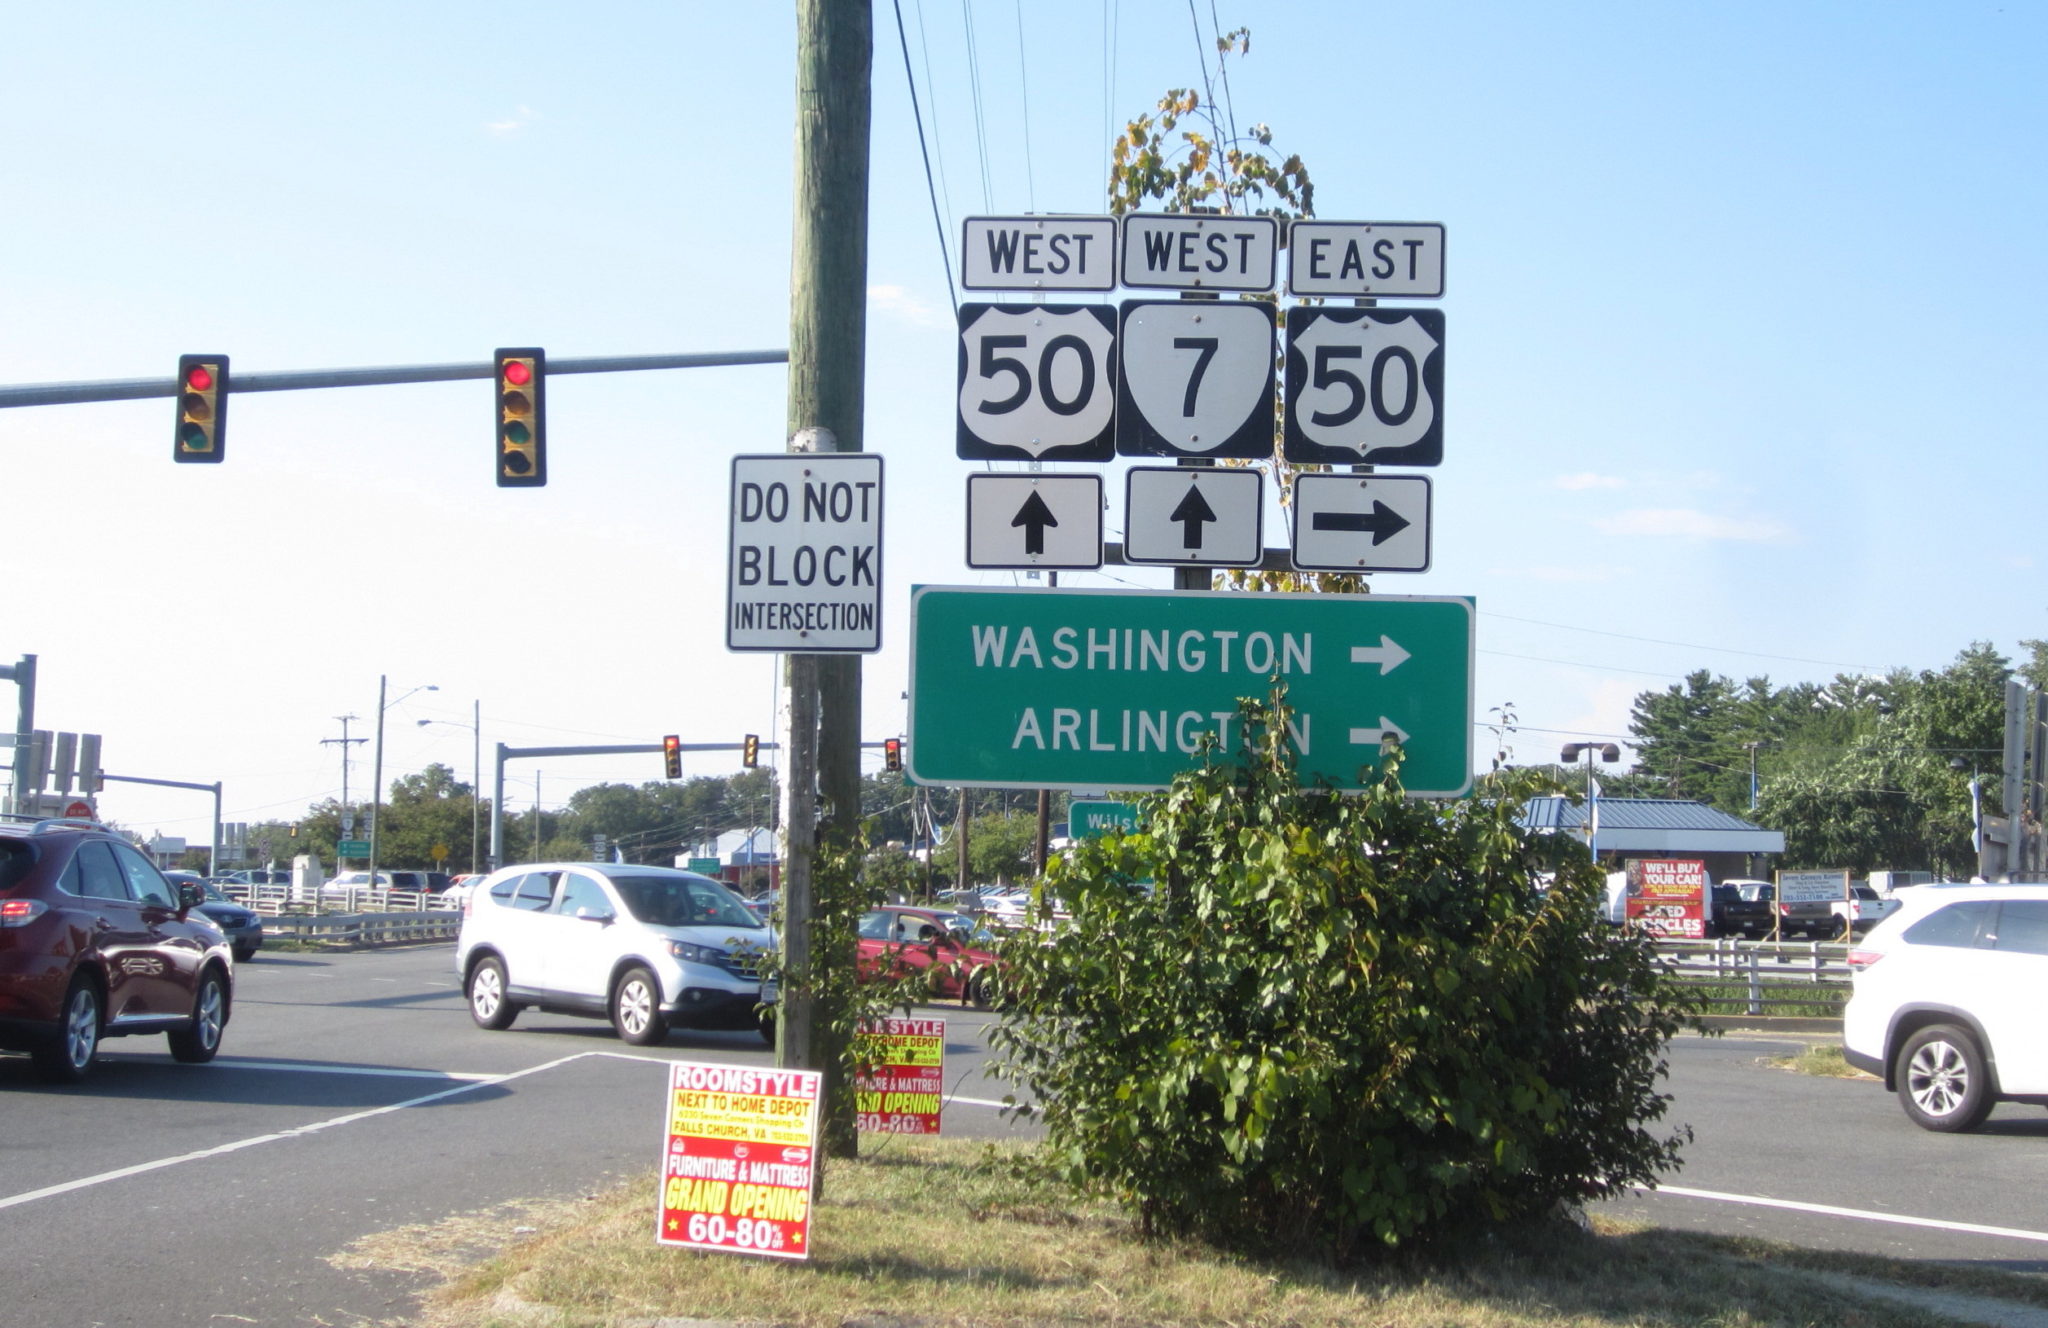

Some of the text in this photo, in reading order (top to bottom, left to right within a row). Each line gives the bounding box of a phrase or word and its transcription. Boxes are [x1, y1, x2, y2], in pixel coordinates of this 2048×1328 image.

[986, 229, 1094, 276] WEST
[1143, 230, 1256, 275] WEST
[1309, 238, 1425, 281] EAST
[977, 333, 1096, 416] 50
[1173, 337, 1219, 418] 7
[1311, 345, 1419, 427] 50
[740, 481, 876, 523] DO NOT
[738, 545, 875, 587] BLOCK
[735, 602, 873, 631] INTERSECTION
[971, 625, 1312, 675] WASHINGTON
[1644, 874, 1702, 885] YOUR CAR!
[1645, 862, 1700, 873] WE'LL BUY
[910, 1038, 940, 1048] DEPOT
[675, 1066, 816, 1098] ROOMSTYLE
[889, 1078, 896, 1091] &
[898, 1078, 941, 1093] MATTRESS
[677, 1092, 810, 1117] NEXT TO HOME DEPOT
[884, 1093, 940, 1115] OPENING
[674, 1121, 703, 1134] FALLS
[754, 1128, 766, 1139] VA
[668, 1154, 809, 1187] FURNITURE & MATTRESS
[665, 1177, 808, 1222] GRAND OPENING
